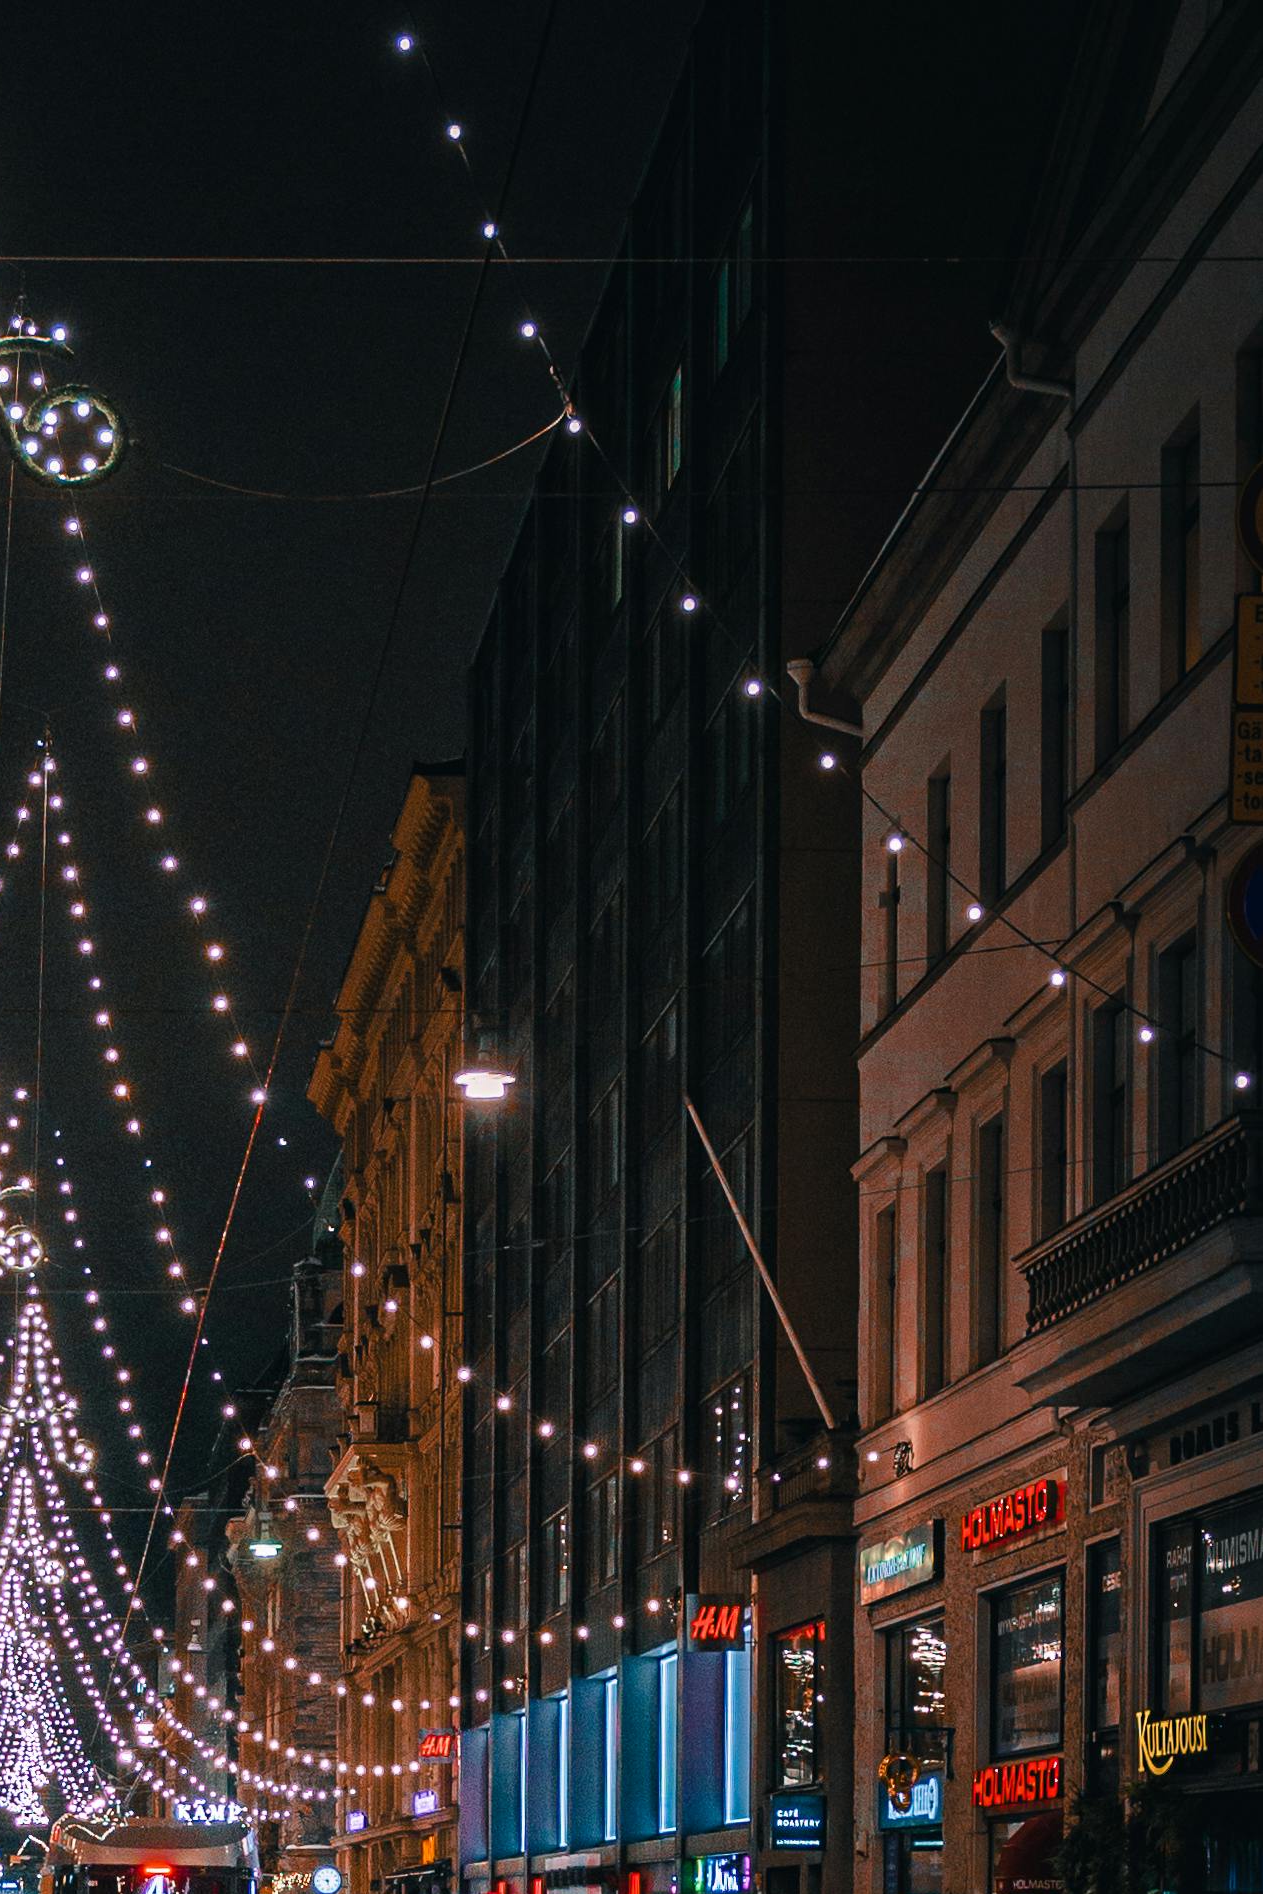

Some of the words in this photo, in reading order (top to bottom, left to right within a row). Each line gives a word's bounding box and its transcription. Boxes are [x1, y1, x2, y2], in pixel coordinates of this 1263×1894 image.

[961, 1480, 1049, 1553] HOLMASTO
[690, 1605, 741, 1641] H&M
[420, 1735, 452, 1757] H&M
[1136, 1709, 1208, 1776] KULTAJOUSI
[972, 1759, 1060, 1807] HOLMASTO
[176, 1798, 243, 1824] KÄMP
[776, 1808, 798, 1818] CAFÉ
[776, 1819, 821, 1827] ROASTERY
